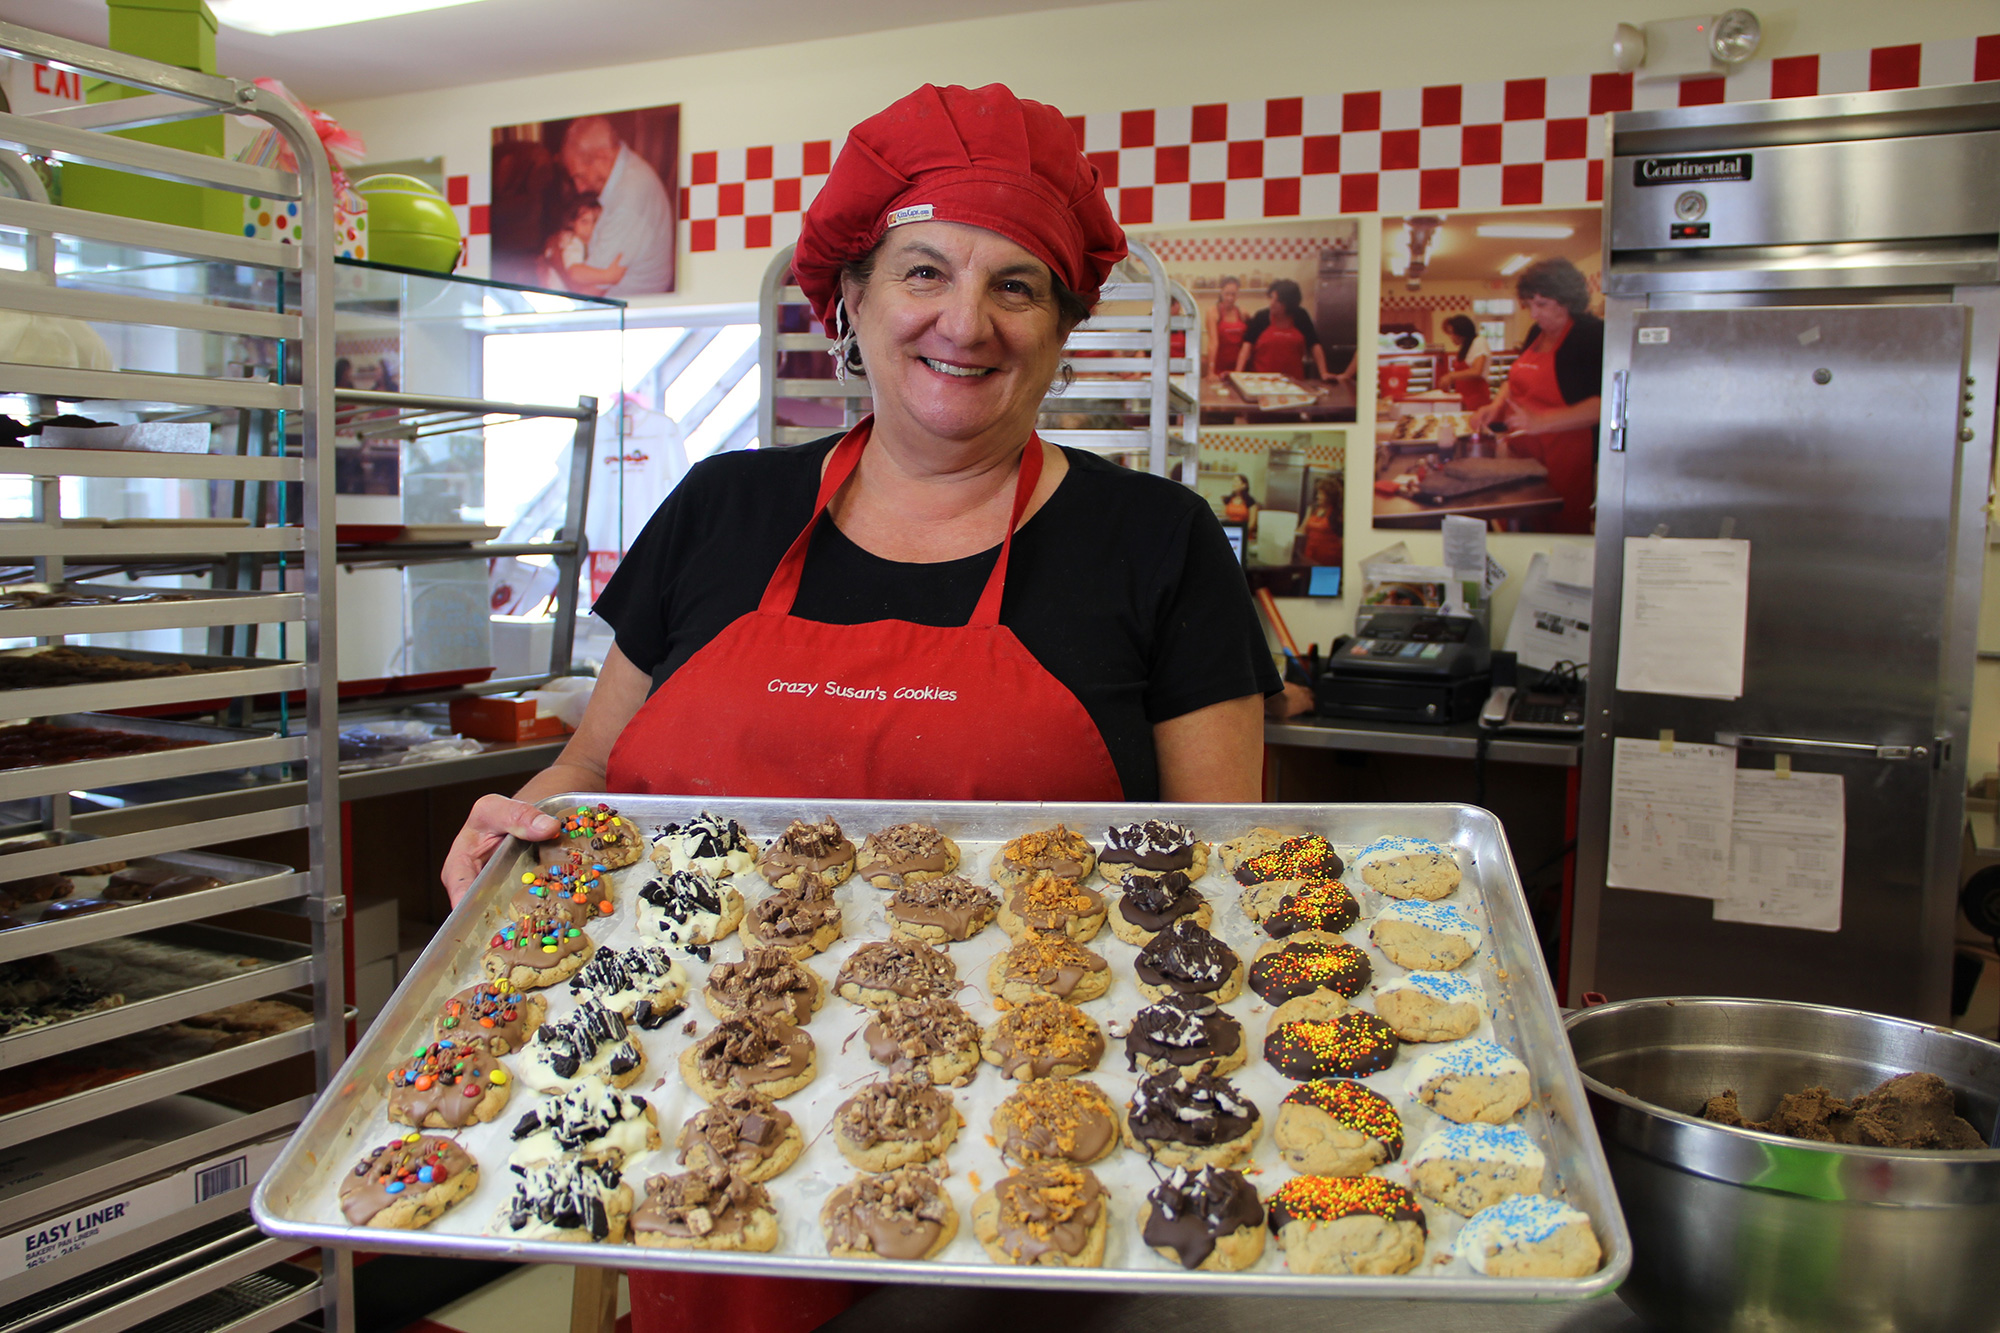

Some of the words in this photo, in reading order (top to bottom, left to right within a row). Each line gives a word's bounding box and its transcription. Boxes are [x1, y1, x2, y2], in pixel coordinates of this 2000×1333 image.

[33, 62, 80, 102] EXI
[1643, 157, 1742, 179] Continental
[767, 678, 819, 698] Crazy
[824, 681, 887, 701] Susan's
[25, 1220, 72, 1252] EASY
[25, 1244, 57, 1261] BAKERY
[57, 1238, 73, 1248] PAN
[74, 1227, 100, 1242] LINERS
